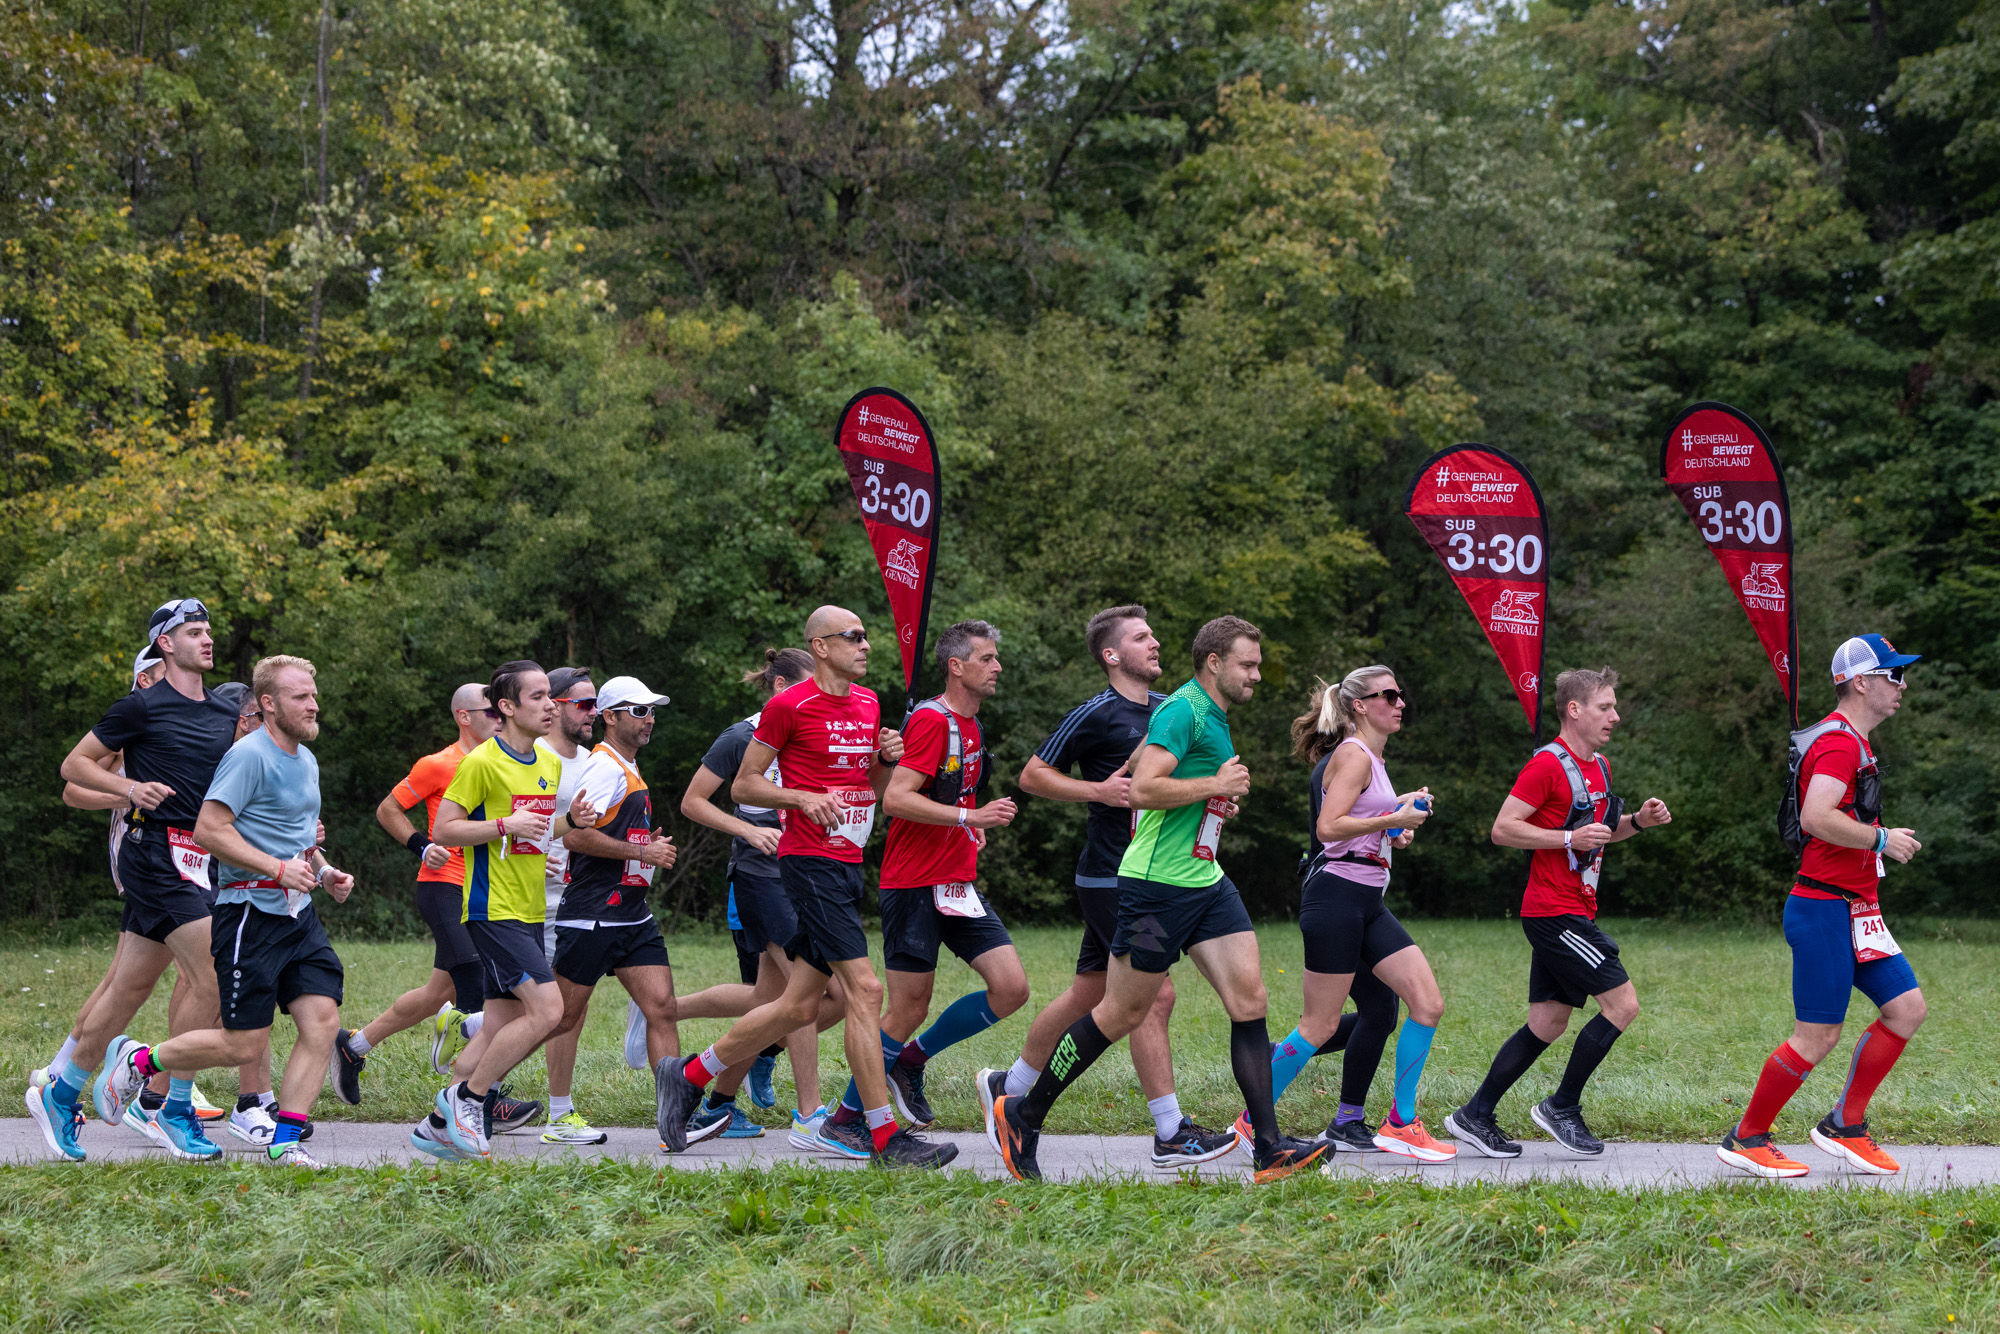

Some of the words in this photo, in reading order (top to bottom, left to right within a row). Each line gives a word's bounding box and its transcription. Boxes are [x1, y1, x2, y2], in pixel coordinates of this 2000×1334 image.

[858, 405, 908, 430] #GENERALI
[858, 431, 915, 454] DEUTSCHLAND
[884, 427, 920, 444] BEWEGT
[1682, 429, 1739, 451] #GENERALI
[1712, 445, 1754, 456] BEWEGT
[863, 459, 885, 475] SUB
[1684, 457, 1751, 469] DEUTSCHLAND
[1436, 466, 1503, 487] #GENERALI
[1471, 483, 1519, 492] BEWEGT
[1693, 485, 1722, 499] SUB
[862, 475, 930, 527] 3:30
[1436, 493, 1514, 503] DEUTSCHLAND
[1445, 520, 1476, 530] SUB
[1700, 500, 1782, 544] 3:30
[1447, 533, 1542, 574] 3:30
[885, 569, 918, 589] GENERALI
[1745, 598, 1785, 611] GENERALI
[1490, 622, 1539, 636] GENERALI
[182, 853, 203, 870] 4814
[945, 884, 966, 898] 2168
